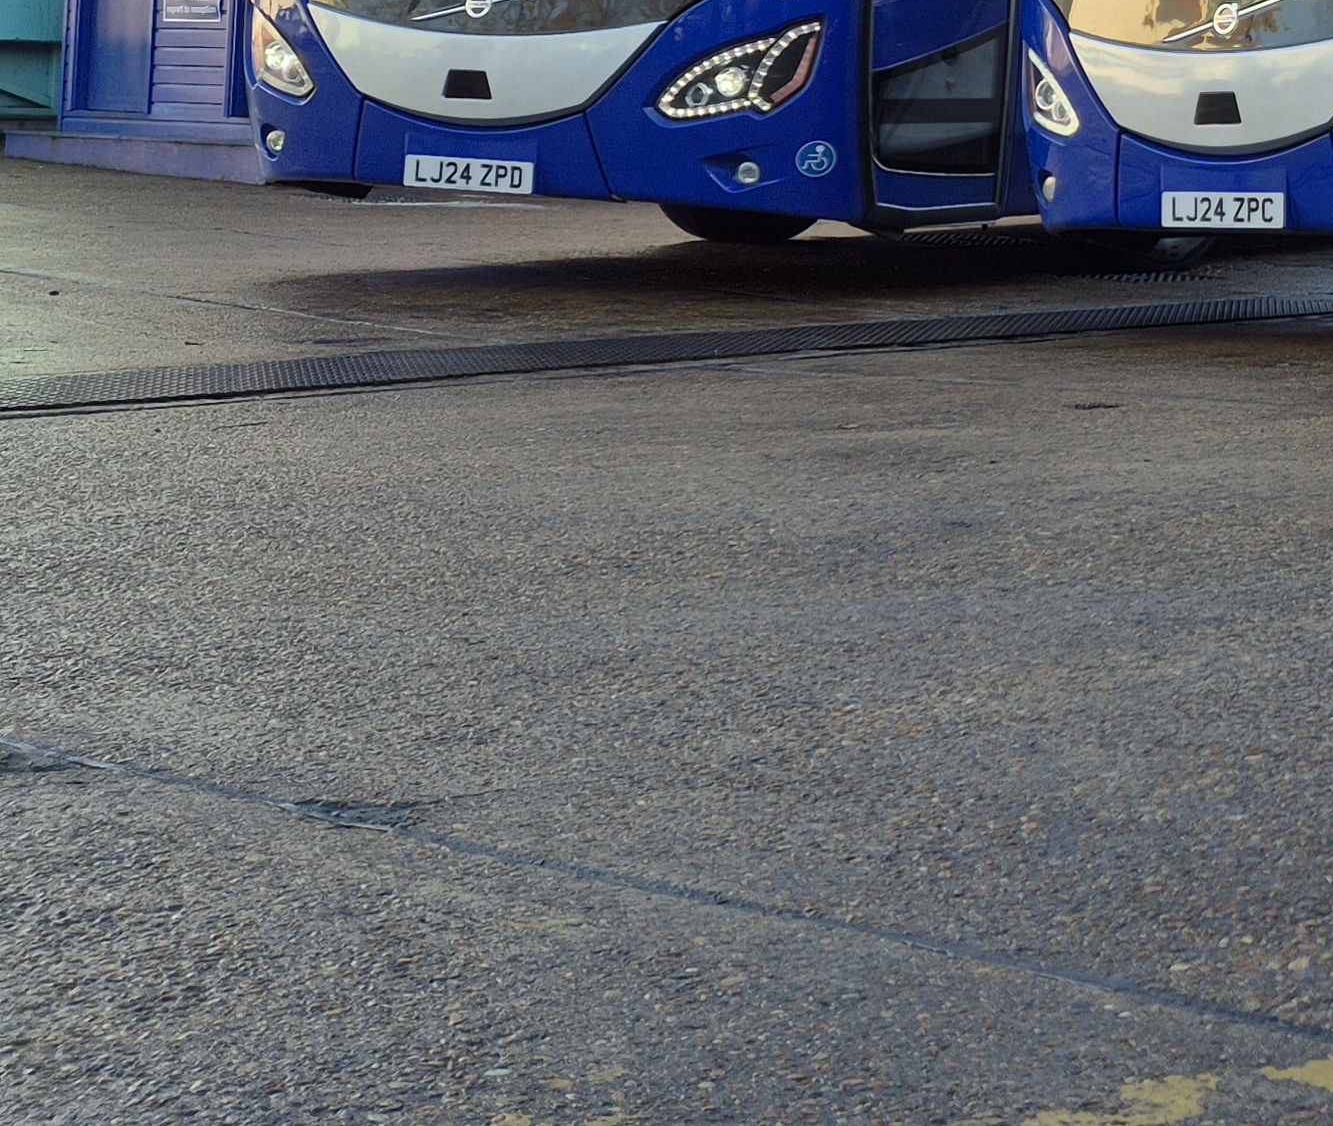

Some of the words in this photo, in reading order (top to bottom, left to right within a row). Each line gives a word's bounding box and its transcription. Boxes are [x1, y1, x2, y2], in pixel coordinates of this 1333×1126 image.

[415, 159, 472, 185] LJ24
[480, 163, 523, 189] ZPD
[1172, 196, 1226, 222] LJ24
[1233, 197, 1274, 223] ZPC
